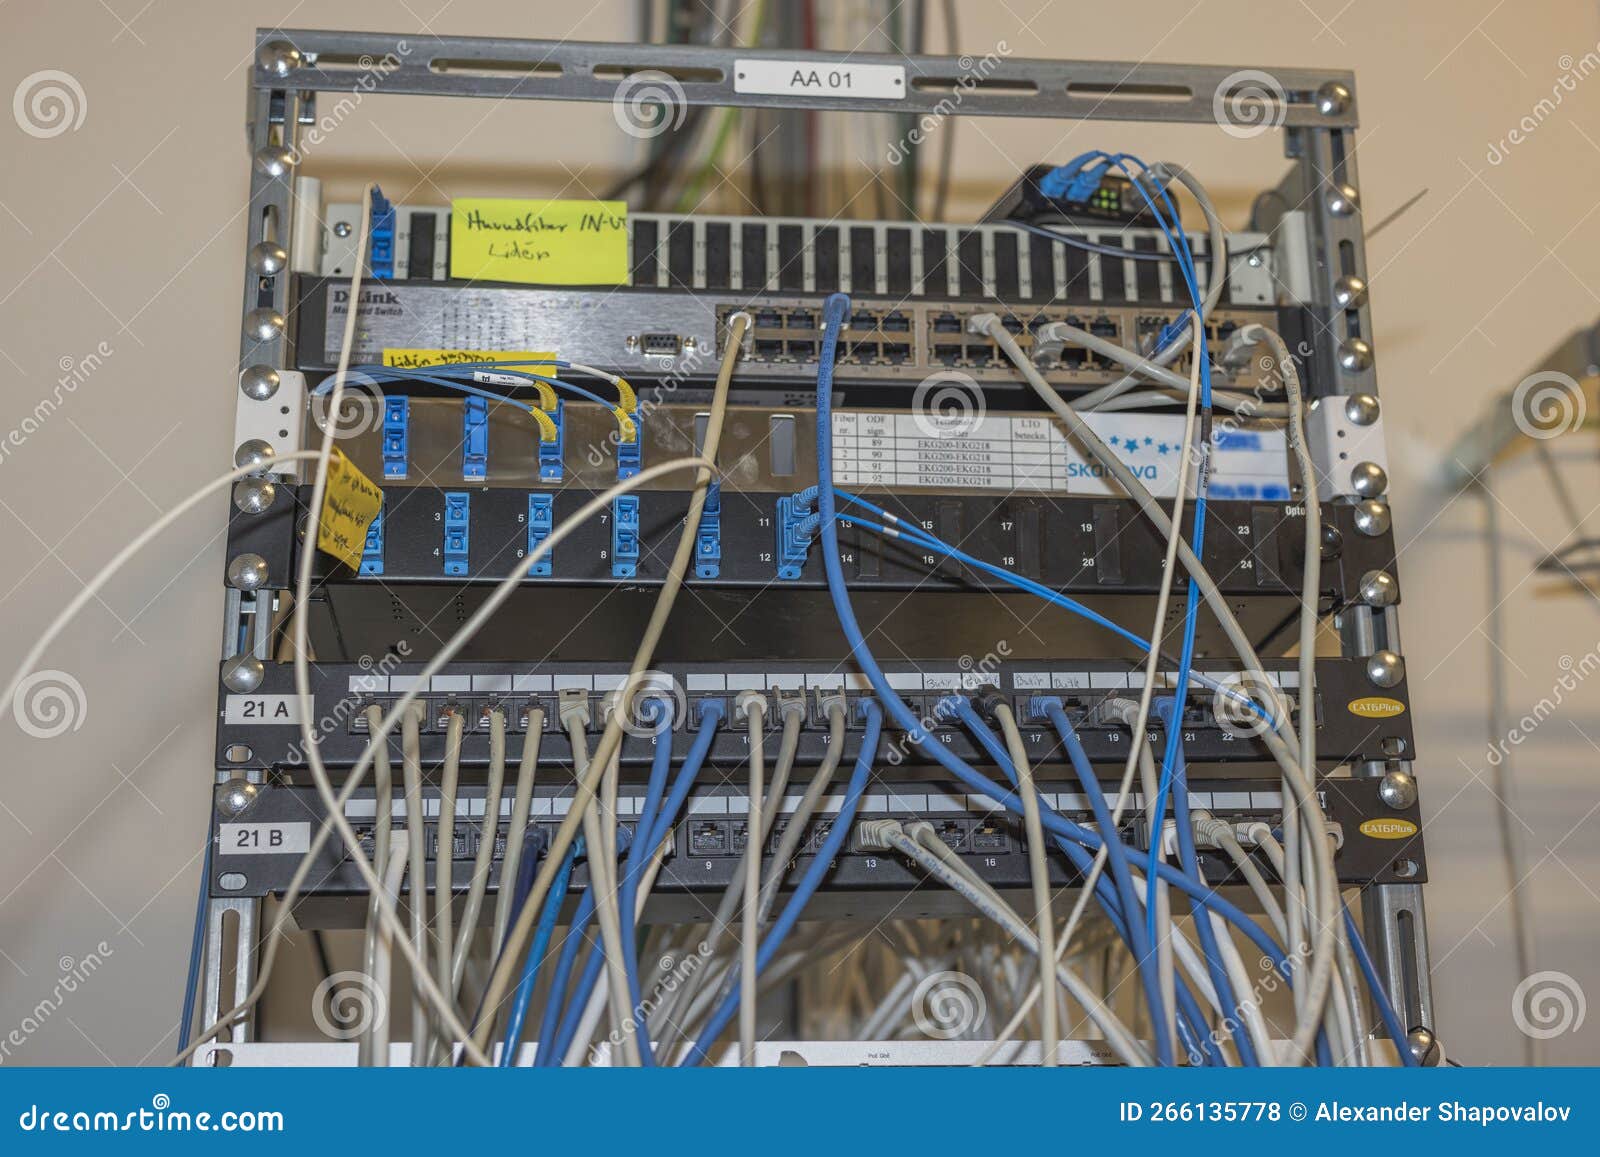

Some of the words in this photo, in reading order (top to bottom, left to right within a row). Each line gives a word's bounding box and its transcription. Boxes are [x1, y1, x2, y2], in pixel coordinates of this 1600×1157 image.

[790, 70, 821, 87] AA
[828, 71, 851, 88] 01
[334, 290, 400, 304] Dink
[374, 306, 404, 316] Switch
[871, 439, 882, 447] 89
[917, 440, 991, 450] EKG200-EKG218
[918, 452, 991, 461] EKG200-EKG218
[918, 464, 991, 473] EKG200-EKG218
[919, 476, 992, 485] EKG200-EKG218
[434, 513, 441, 521] 3
[518, 514, 525, 522] 5
[601, 516, 607, 524] 7
[759, 518, 769, 527] 11
[841, 520, 852, 528] 13
[921, 520, 933, 529] 15
[1001, 522, 1012, 530] 17
[1081, 524, 1092, 532] 19
[1238, 526, 1250, 534] 23
[433, 548, 439, 556] 4
[517, 550, 523, 558] 6
[601, 551, 607, 559] 8
[759, 553, 771, 562] 12
[841, 554, 852, 562] 14
[922, 556, 934, 564] 16
[1002, 557, 1014, 565] 18
[1083, 559, 1094, 567] 20
[1240, 561, 1252, 569] 24
[243, 701, 264, 718] 21
[274, 702, 289, 718] A
[1352, 703, 1400, 712] CAT6Plus
[1031, 734, 1041, 742] 17
[1108, 733, 1119, 742] 19
[1185, 733, 1196, 742] 21
[1222, 732, 1234, 741] 22
[1364, 825, 1412, 834] CAT6Plus
[237, 830, 259, 847] 21
[270, 830, 283, 847] B
[705, 860, 712, 870] 9
[865, 859, 876, 868] 13
[985, 858, 996, 867] 16
